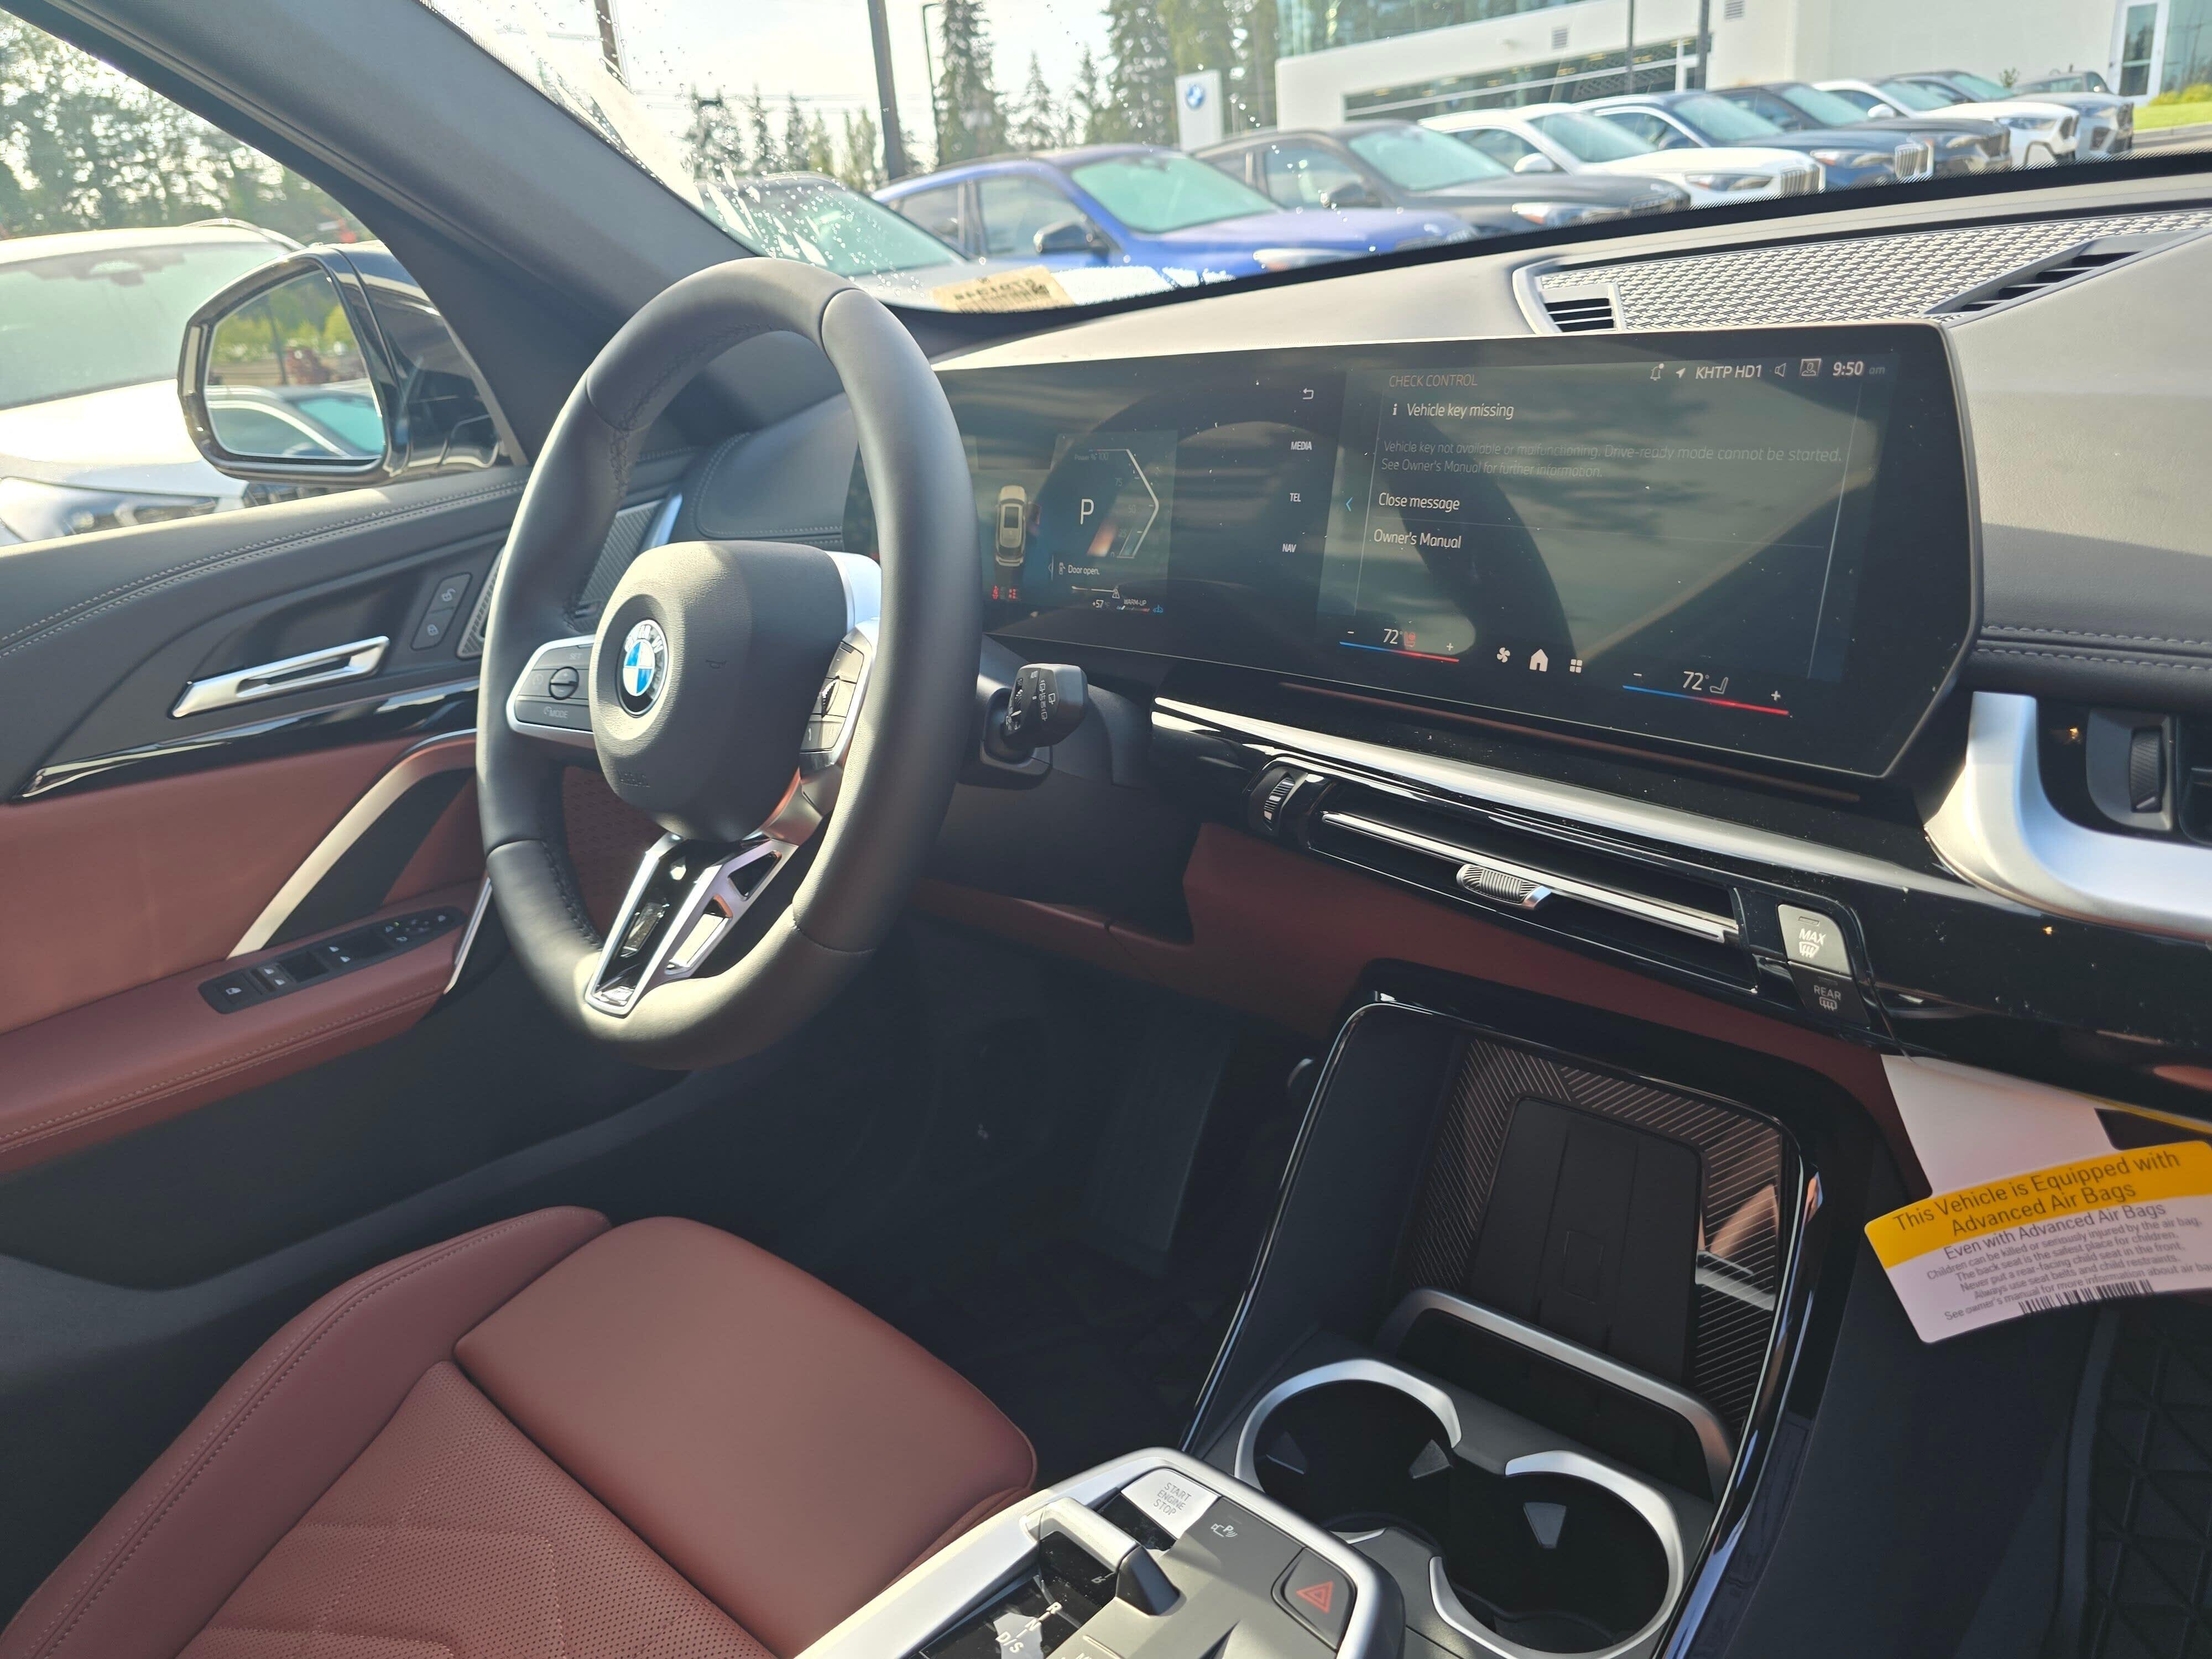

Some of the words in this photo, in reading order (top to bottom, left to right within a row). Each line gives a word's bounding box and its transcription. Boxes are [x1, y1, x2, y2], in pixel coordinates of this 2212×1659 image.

[1695, 366, 1733, 379] KHTP
[1735, 364, 1762, 379] HD1
[1832, 361, 1864, 377] 9:50
[1869, 366, 1885, 375] am
[1389, 375, 1423, 388] CHECK
[1425, 374, 1478, 387] CONTROL
[1406, 403, 1444, 417] Vehicle
[1447, 404, 1467, 419] key
[1469, 403, 1514, 420] missing
[1290, 441, 1312, 451] MEDIA
[1383, 441, 1417, 452] Vehicle
[1419, 442, 1436, 455] key
[1437, 444, 1454, 453] not
[1456, 443, 1501, 455] available
[1504, 445, 1515, 455] or
[1517, 443, 1601, 460] malfunctioning.
[1604, 445, 1674, 461] Drive-ready
[1677, 446, 1714, 460] mode
[1718, 447, 1763, 461] cannot
[1766, 447, 1783, 461] be
[1788, 447, 1842, 462] started.
[1381, 458, 1400, 470] See
[1402, 458, 1441, 471] Owner's
[1444, 460, 1481, 473] Manual
[1483, 461, 1498, 474] for
[1499, 462, 1535, 476] further
[1536, 464, 1603, 478] information.
[1289, 492, 1301, 502] TEL
[1379, 492, 1407, 508] Close
[1410, 497, 1460, 513] message
[1079, 498, 1094, 525] P
[1282, 543, 1297, 553] NAV
[1373, 529, 1417, 546] Owner's
[1420, 533, 1462, 549] Manual
[1067, 564, 1082, 575] Door
[1083, 567, 1100, 576] open.
[549, 709, 569, 718] MODE
[1798, 927, 1827, 946] MAX
[1813, 984, 1841, 1001] REAR
[1893, 1207, 1935, 1231] This
[1934, 1187, 2008, 1215] Vehicle
[2008, 1181, 2029, 1197] is
[2030, 1156, 2131, 1192] Equipped
[2133, 1150, 2182, 1171] with
[1952, 1197, 2047, 1237] Advanced
[2051, 1191, 2078, 1211] Air
[2080, 1183, 2136, 1204] Bags
[1943, 1241, 1981, 1260] Even
[1982, 1230, 2016, 1248] with
[2018, 1211, 2095, 1240] Advanced
[2098, 1208, 2119, 1224] Air
[2122, 1203, 2167, 1219] Bags
[1927, 1261, 1968, 1280] Children
[1968, 1256, 1987, 1267] can
[1986, 1251, 2001, 1261] be
[2000, 1243, 2028, 1258] killed
[2030, 1243, 2039, 1251] or
[2042, 1232, 2087, 1248] seriously
[2088, 1224, 2125, 1239] injured
[2125, 1223, 2140, 1234] by
[2141, 1220, 2160, 1230] the
[2162, 1219, 2175, 1229] air
[2176, 1216, 2203, 1228] bag.
[1955, 1270, 1976, 1282] The
[1975, 1262, 2001, 1275] back
[2001, 1257, 2023, 1270] seat
[2023, 1255, 2033, 1264] is
[2032, 1250, 2052, 1261] the
[2052, 1243, 2084, 1258] safest
[2084, 1239, 2114, 1253] place
[2114, 1235, 2130, 1246] for
[2132, 1231, 2179, 1244] children.
[1959, 1278, 1989, 1292] Never
[1989, 1272, 2007, 1286] put
[2016, 1258, 2072, 1277] rear-facing
[2072, 1253, 2098, 1266] child
[2099, 1248, 2123, 1260] seat
[2123, 1246, 2134, 1256] in
[2134, 1244, 2153, 1255] the
[2153, 1241, 2186, 1252] front.
[1974, 1284, 2008, 1301] Always
[2008, 1279, 2028, 1290] use
[2028, 1274, 2050, 1285] seat
[2051, 1265, 2077, 1281] belts
[2079, 1264, 2098, 1275] and
[2099, 1259, 2125, 1271] child
[2126, 1253, 2181, 1267] restraints.
[1943, 1309, 1965, 1321] See
[1964, 1297, 2004, 1314] owner's
[2003, 1288, 2040, 1302] manual
[2040, 1282, 2055, 1293] for
[2056, 1278, 2084, 1290] more
[2085, 1269, 2147, 1285] information
[2147, 1265, 2180, 1276] about
[2180, 1263, 2193, 1272] air
[1157, 1489, 1186, 1511] ENGINE
[1164, 1481, 1192, 1501] START
[1153, 1498, 1177, 1516] STOP
[1046, 1601, 1063, 1615] R
[1024, 1618, 1042, 1631] N
